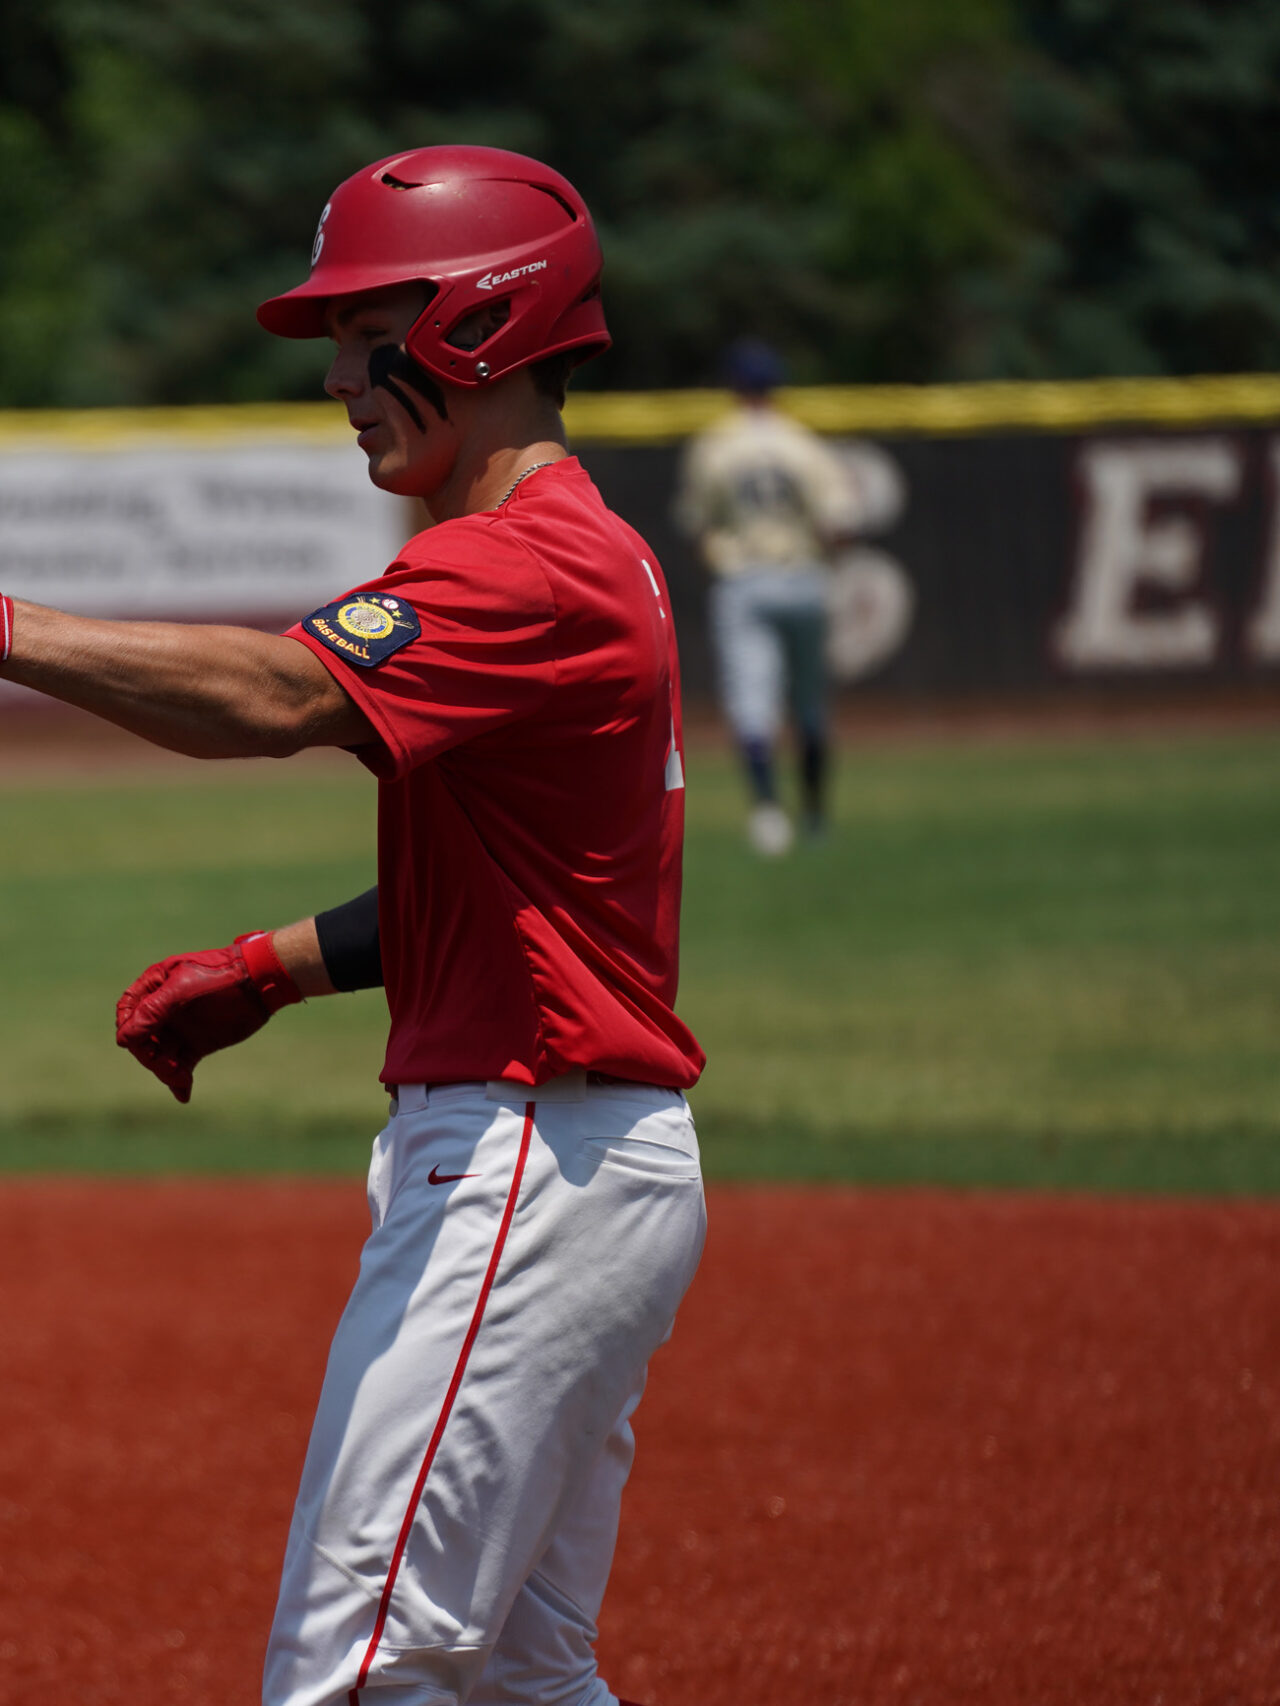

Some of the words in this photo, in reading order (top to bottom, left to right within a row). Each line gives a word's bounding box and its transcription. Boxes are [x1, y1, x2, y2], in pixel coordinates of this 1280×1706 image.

[492, 259, 547, 286] EASTON
[1053, 438, 1280, 666] E
[311, 618, 371, 660] BASEBALL
